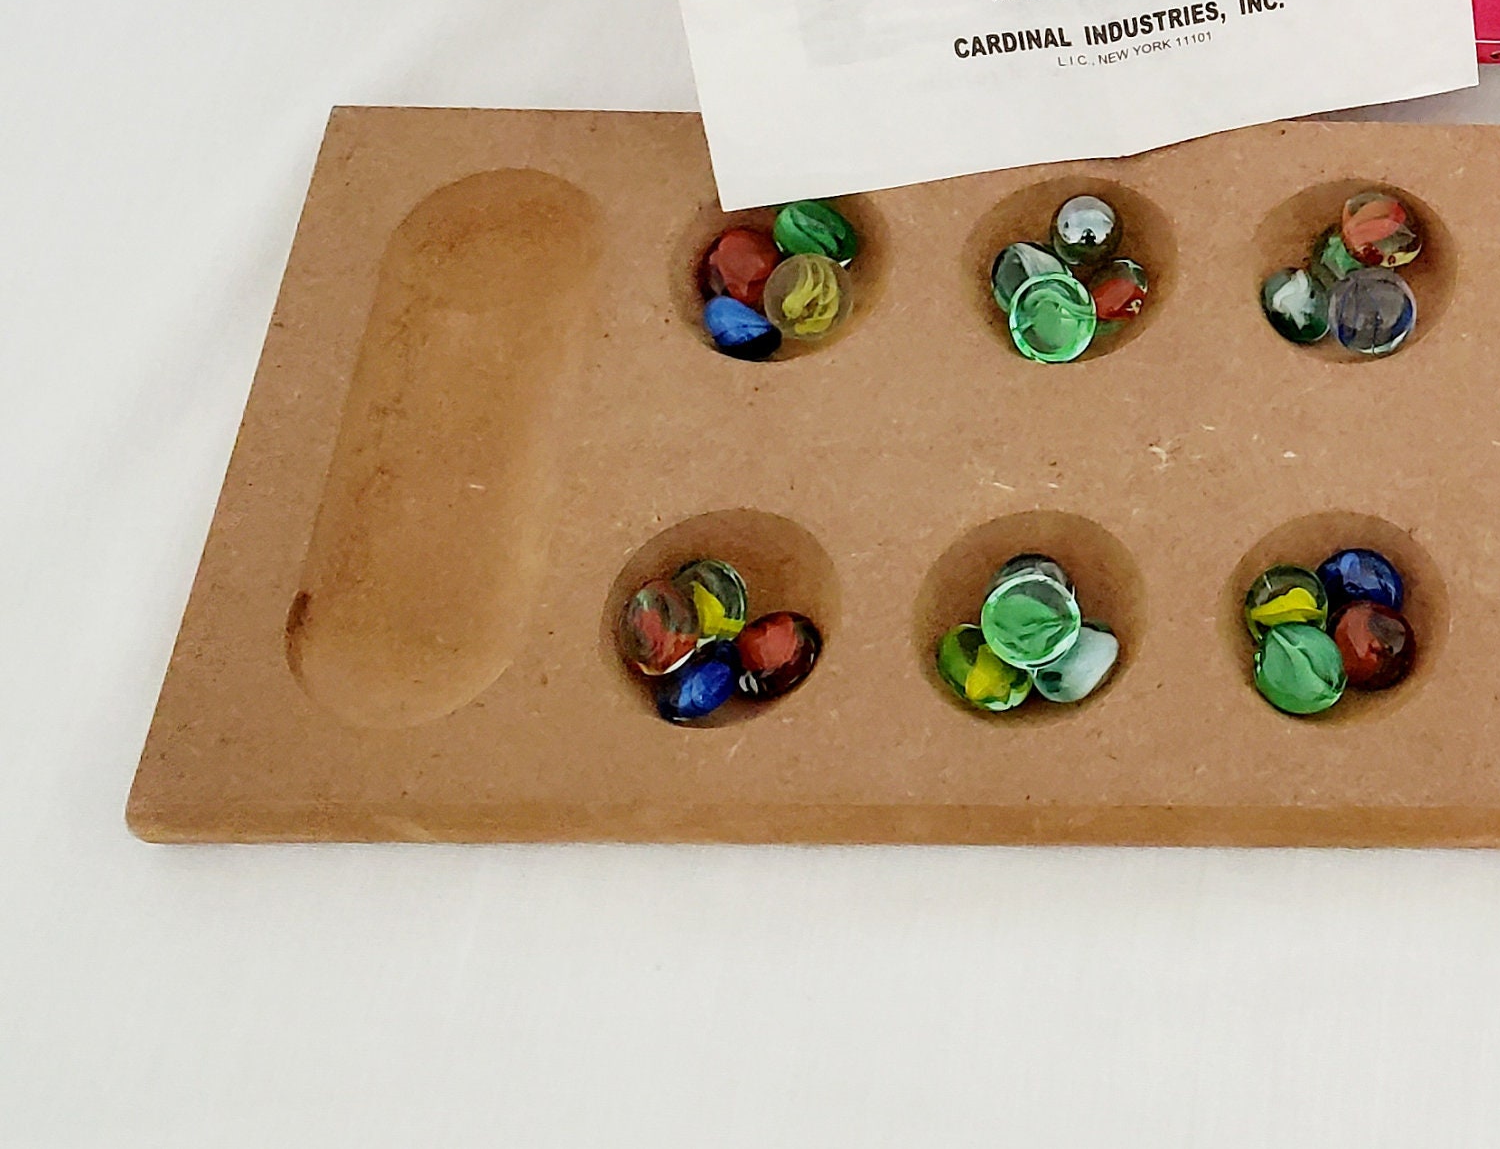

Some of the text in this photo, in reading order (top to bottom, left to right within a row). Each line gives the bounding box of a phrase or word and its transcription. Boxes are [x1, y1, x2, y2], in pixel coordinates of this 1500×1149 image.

[953, 26, 1073, 59] CARDINAL
[1083, 0, 1226, 46] INDUSTRIES,
[1097, 48, 1130, 66] NEW
[1132, 38, 1172, 56] YORK
[1175, 30, 1212, 47] 11101
